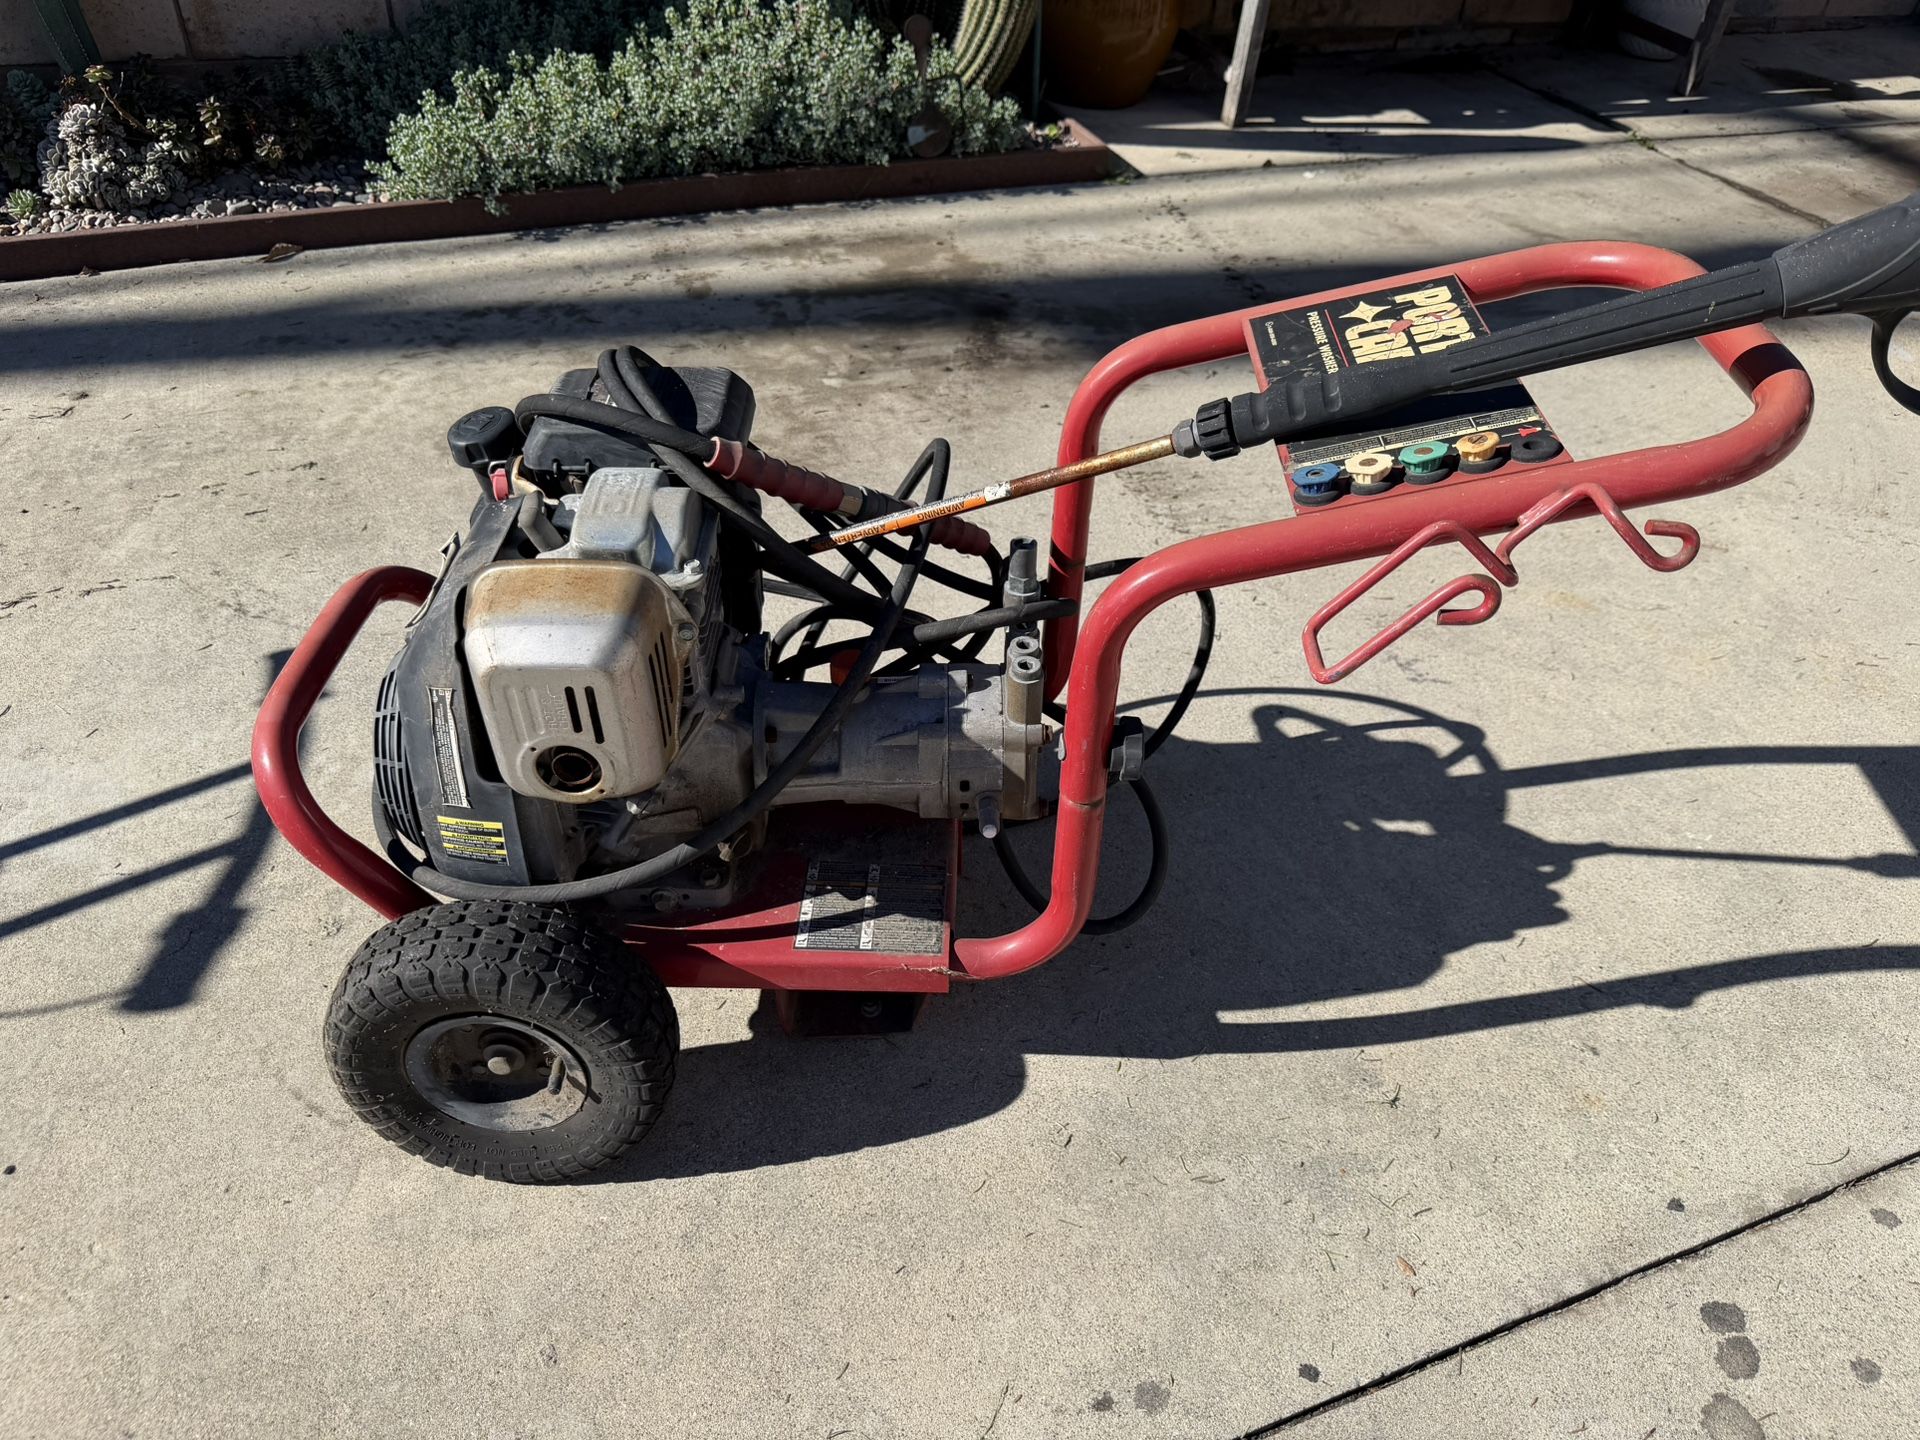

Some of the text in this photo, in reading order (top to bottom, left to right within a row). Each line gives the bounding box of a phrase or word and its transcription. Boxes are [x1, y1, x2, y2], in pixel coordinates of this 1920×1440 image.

[1306, 310, 1339, 375] PRESSURE WASHER
[917, 503, 961, 522] WARNING
